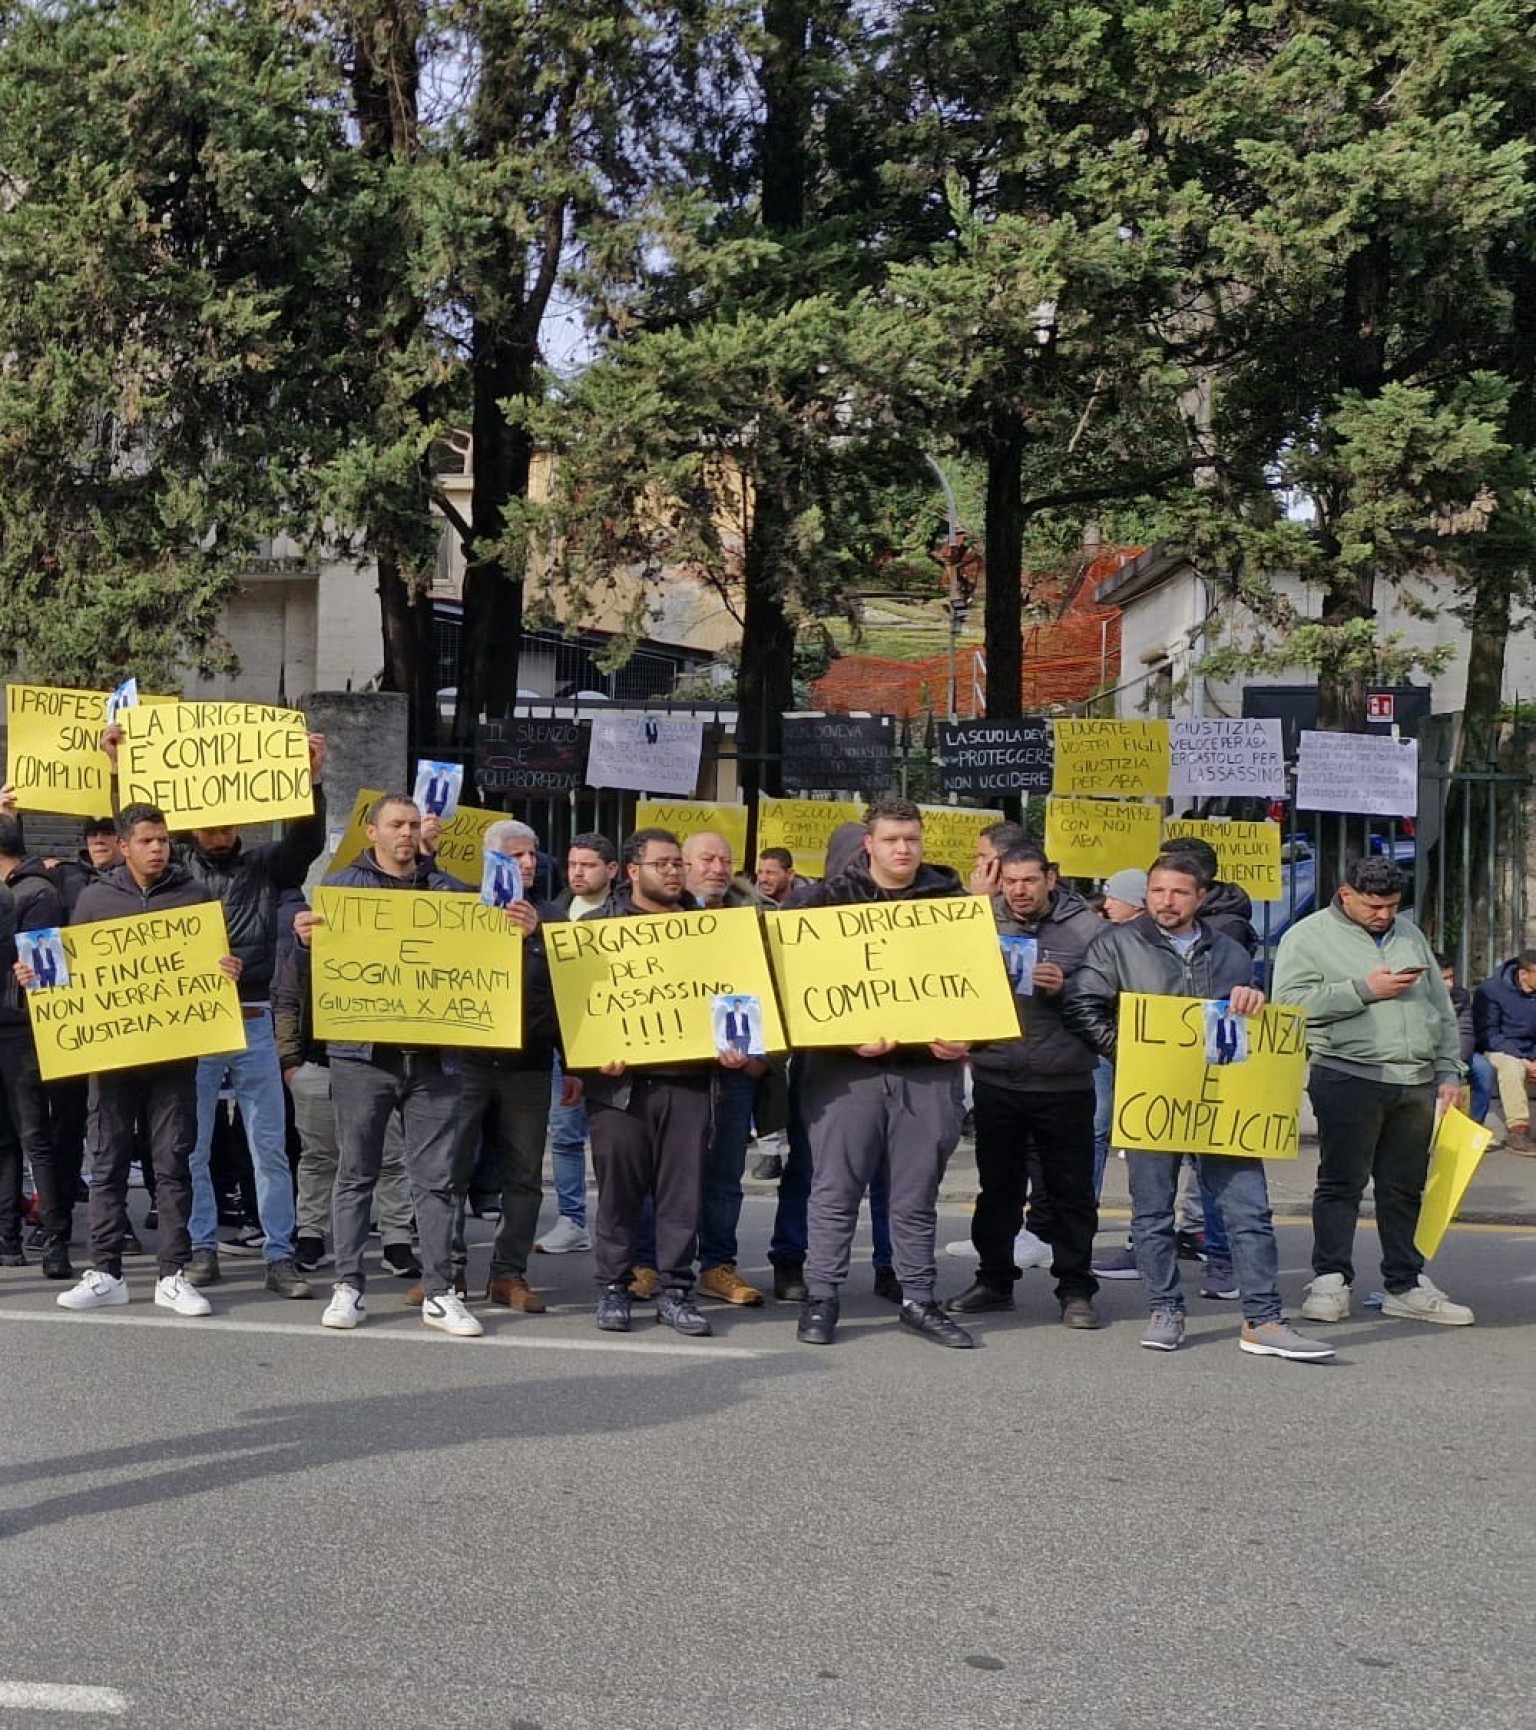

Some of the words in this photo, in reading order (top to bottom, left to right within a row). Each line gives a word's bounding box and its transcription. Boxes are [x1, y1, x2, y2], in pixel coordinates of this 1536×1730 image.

[21, 689, 108, 722] PROFES
[127, 709, 164, 740] LA
[177, 703, 306, 733] DIRIGENZA
[516, 722, 579, 742] SILENZIO
[1058, 721, 1131, 739] EDUCATE
[1175, 721, 1266, 735] GIUSTIZIA
[945, 731, 967, 746] LA
[968, 728, 1022, 744] SCUOLA
[1061, 740, 1109, 754] VOSTRI
[1123, 739, 1162, 754] FIGLI
[1168, 737, 1218, 751] VELOCE
[1220, 736, 1243, 749] PER
[163, 730, 305, 769] COMPLICE
[959, 747, 1053, 768] PROTEGGERE
[1171, 752, 1243, 766] ERGASTOLO
[1252, 752, 1279, 765] PER
[15, 754, 102, 790] COMPLICI
[1072, 757, 1150, 773] GIUSTIZIA
[944, 775, 972, 791] NON
[979, 771, 1051, 789] UCCIDERE
[1071, 775, 1104, 791] PER
[1109, 774, 1144, 789] ABA
[655, 807, 715, 823] NON
[1050, 801, 1087, 817] PER
[1094, 803, 1155, 821] SEMPRE
[1061, 819, 1089, 832] CON
[1102, 820, 1132, 833] NOI
[1237, 823, 1258, 839] LA
[1071, 833, 1104, 848] ABA
[320, 893, 394, 934] VITE
[776, 916, 821, 946] LA
[837, 900, 985, 937] DIRIGENZA
[91, 915, 201, 957] STAREMO
[551, 915, 718, 962] ERGASTOLO
[398, 939, 434, 964] E
[323, 958, 402, 986] SOGNI
[415, 968, 510, 992] INFRANTI
[610, 956, 664, 987] PER
[36, 996, 84, 1024] NON
[177, 973, 232, 997] FATTA
[587, 979, 735, 1017] L'ASSASSINO
[442, 998, 494, 1024] ABA
[1135, 997, 1166, 1045] IL
[56, 1013, 163, 1051] GIUSTIZIA
[183, 1000, 234, 1026] ABA
